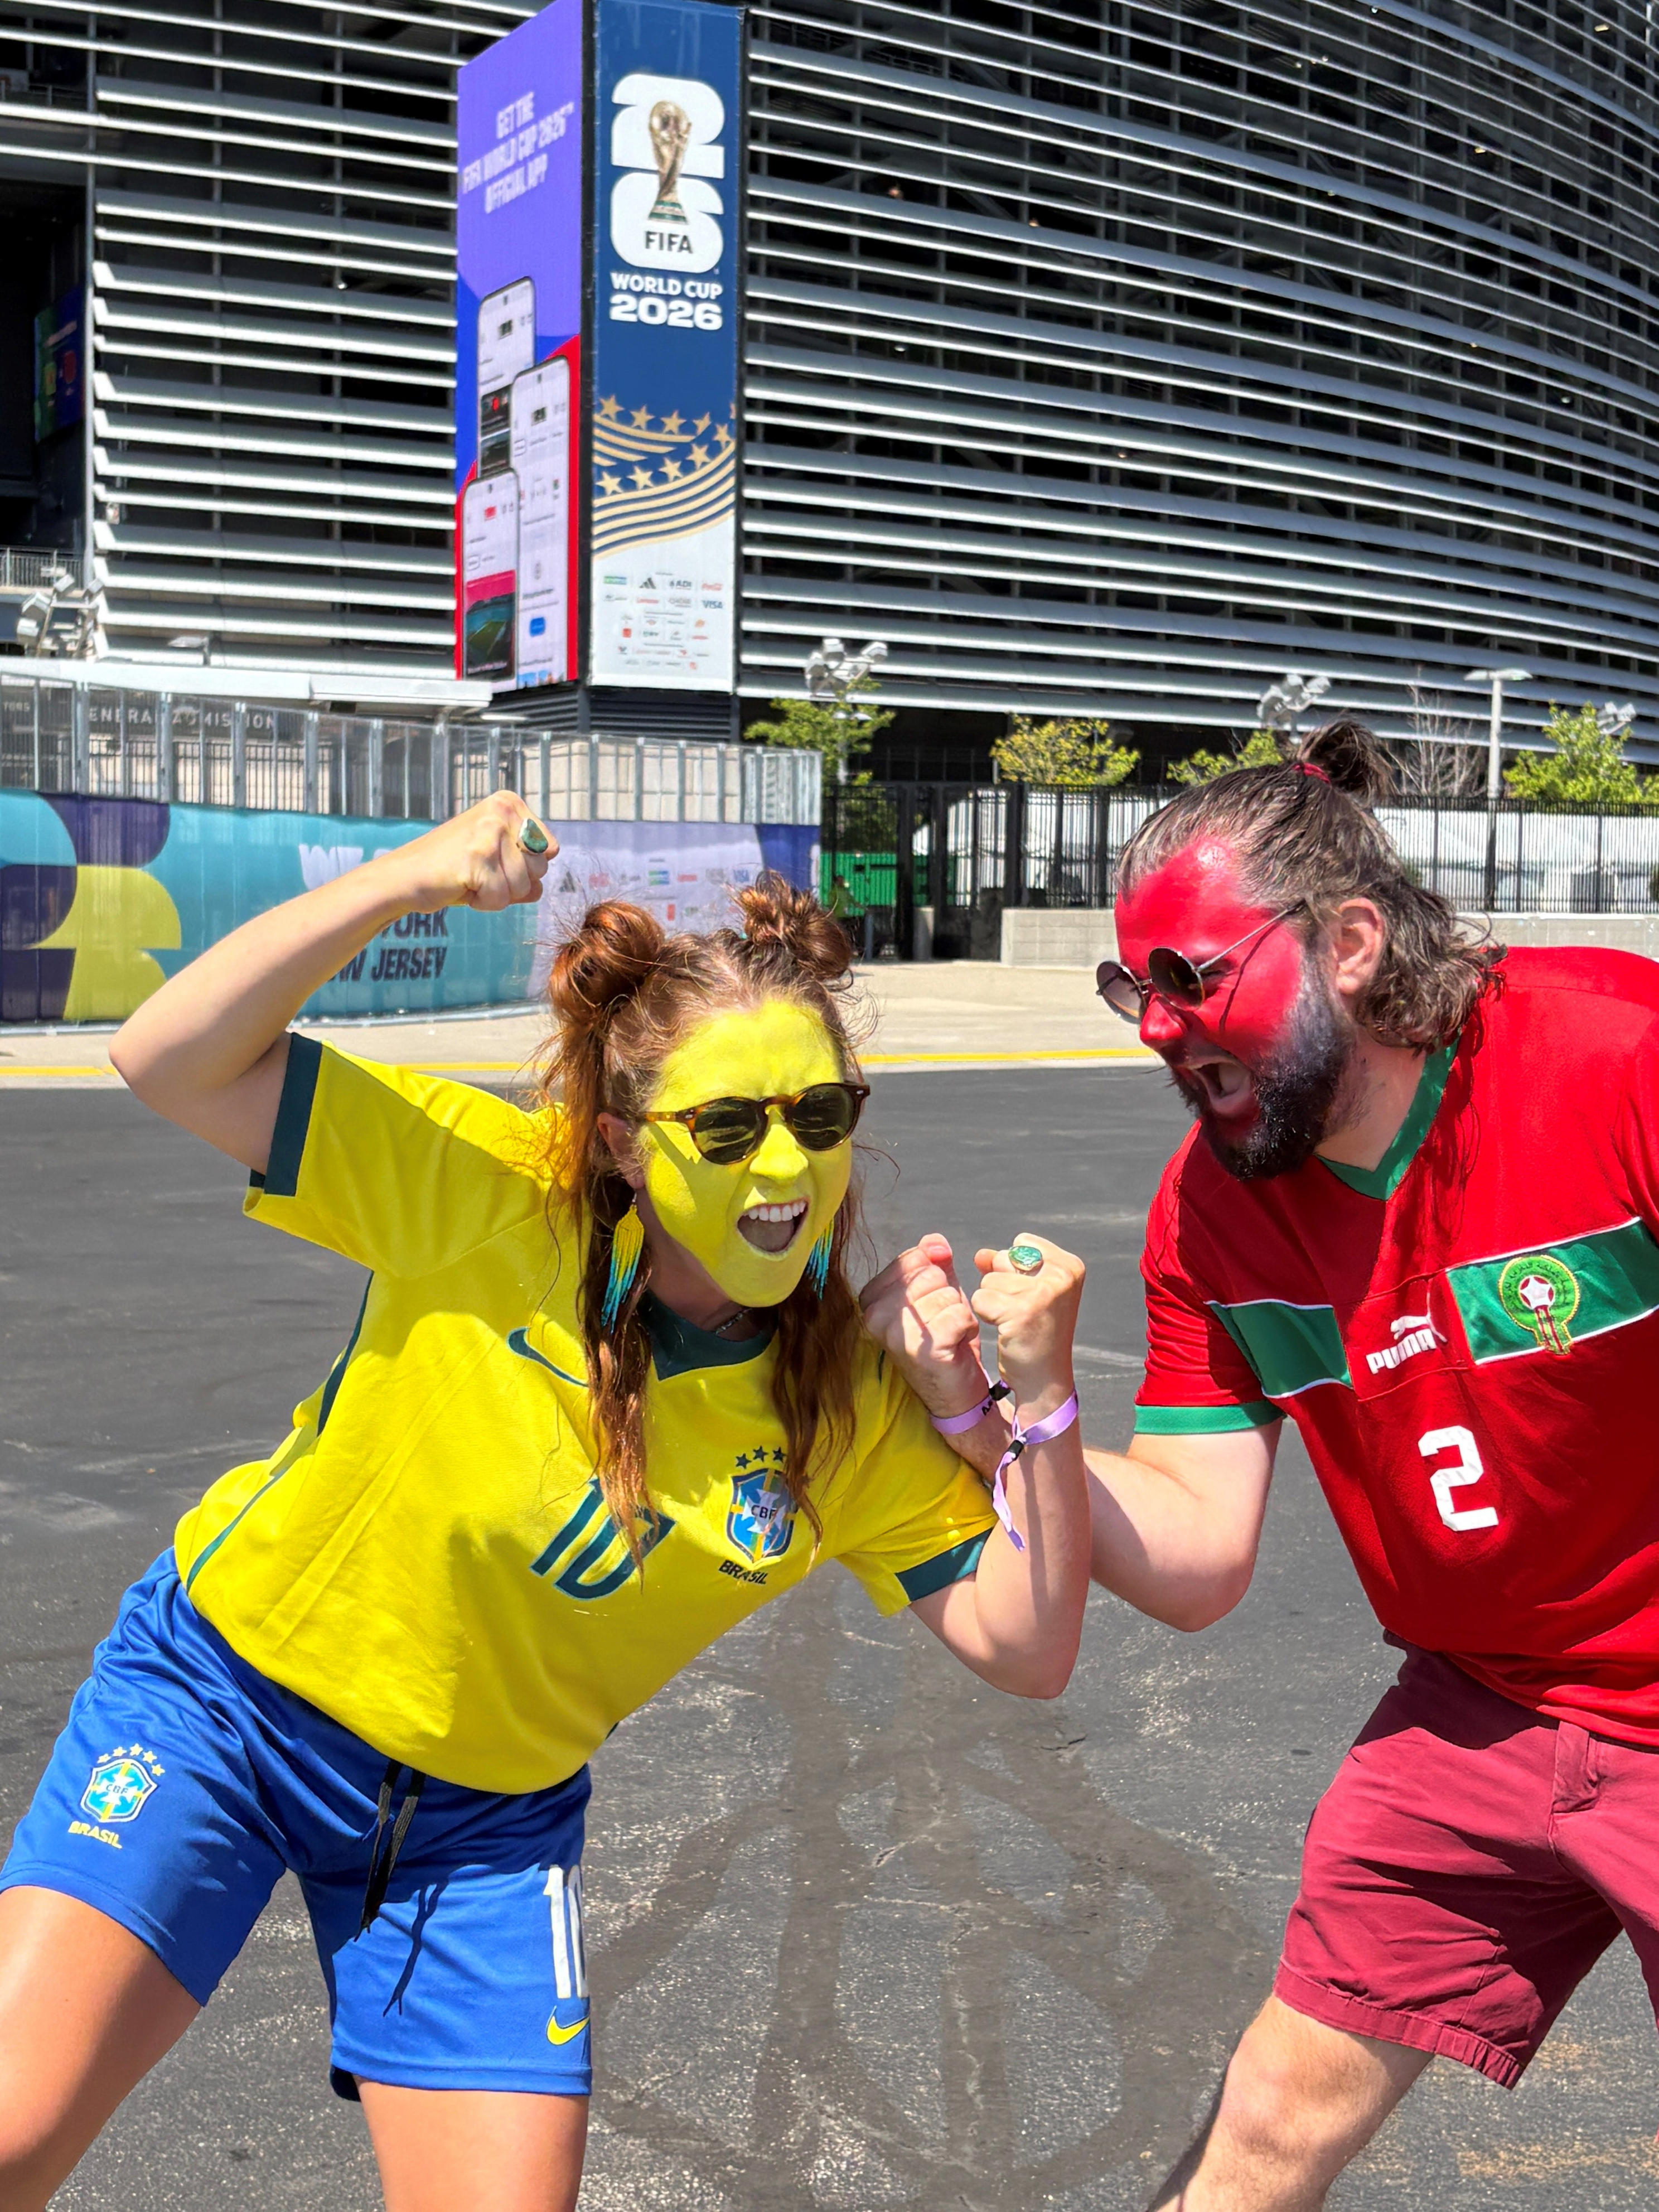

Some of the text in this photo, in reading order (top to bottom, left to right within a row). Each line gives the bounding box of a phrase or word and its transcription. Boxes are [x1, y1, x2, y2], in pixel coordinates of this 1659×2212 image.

[645, 230, 693, 254] FIFA
[611, 272, 723, 300] WORLD CUP
[609, 293, 723, 331] 2026
[382, 906, 448, 939] ORK
[1366, 1328, 1437, 1375] PUMA
[1418, 1425, 1499, 1532] 2
[751, 1504, 777, 1520] CBF
[529, 1476, 677, 1601] 10
[718, 1559, 768, 1585] BRASIL
[105, 1784, 129, 1795] CBF
[67, 1820, 123, 1849] BRASIL
